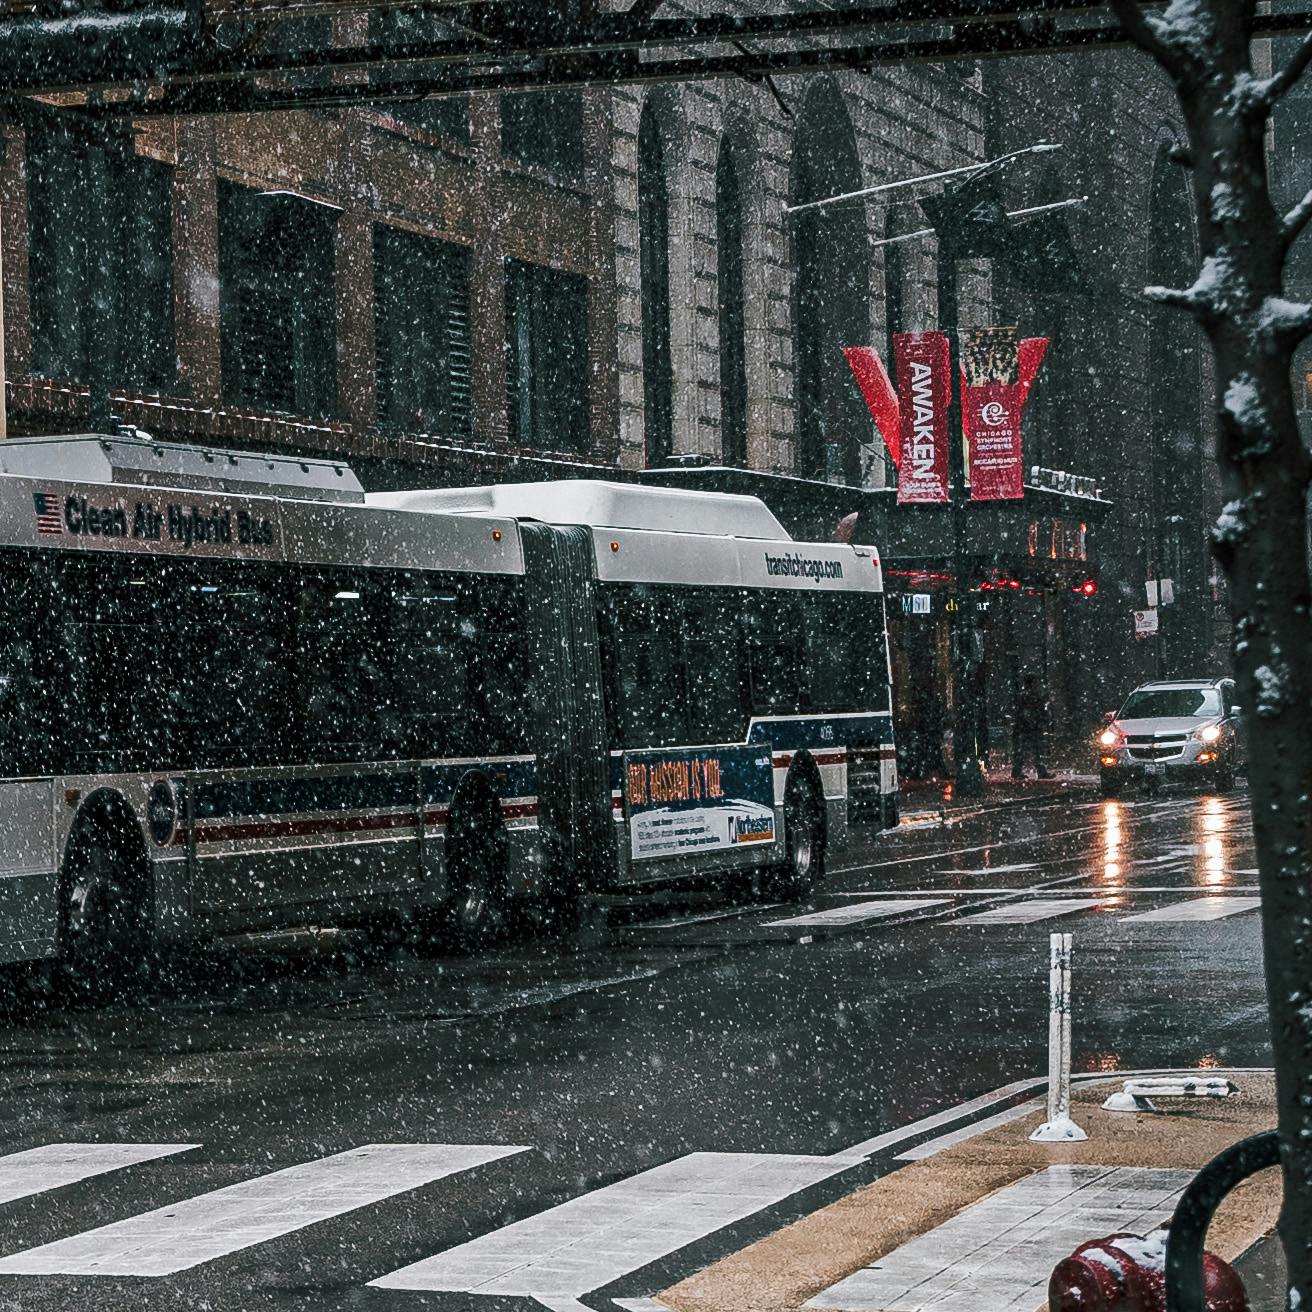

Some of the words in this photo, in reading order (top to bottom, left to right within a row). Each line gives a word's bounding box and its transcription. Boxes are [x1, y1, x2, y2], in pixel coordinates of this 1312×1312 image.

[910, 361, 935, 479] AWAKEN
[64, 495, 127, 537] Clean
[134, 502, 163, 539] Air
[168, 505, 232, 548] Hybrid
[239, 510, 274, 546] Bus
[765, 552, 844, 584] transitchicago.com
